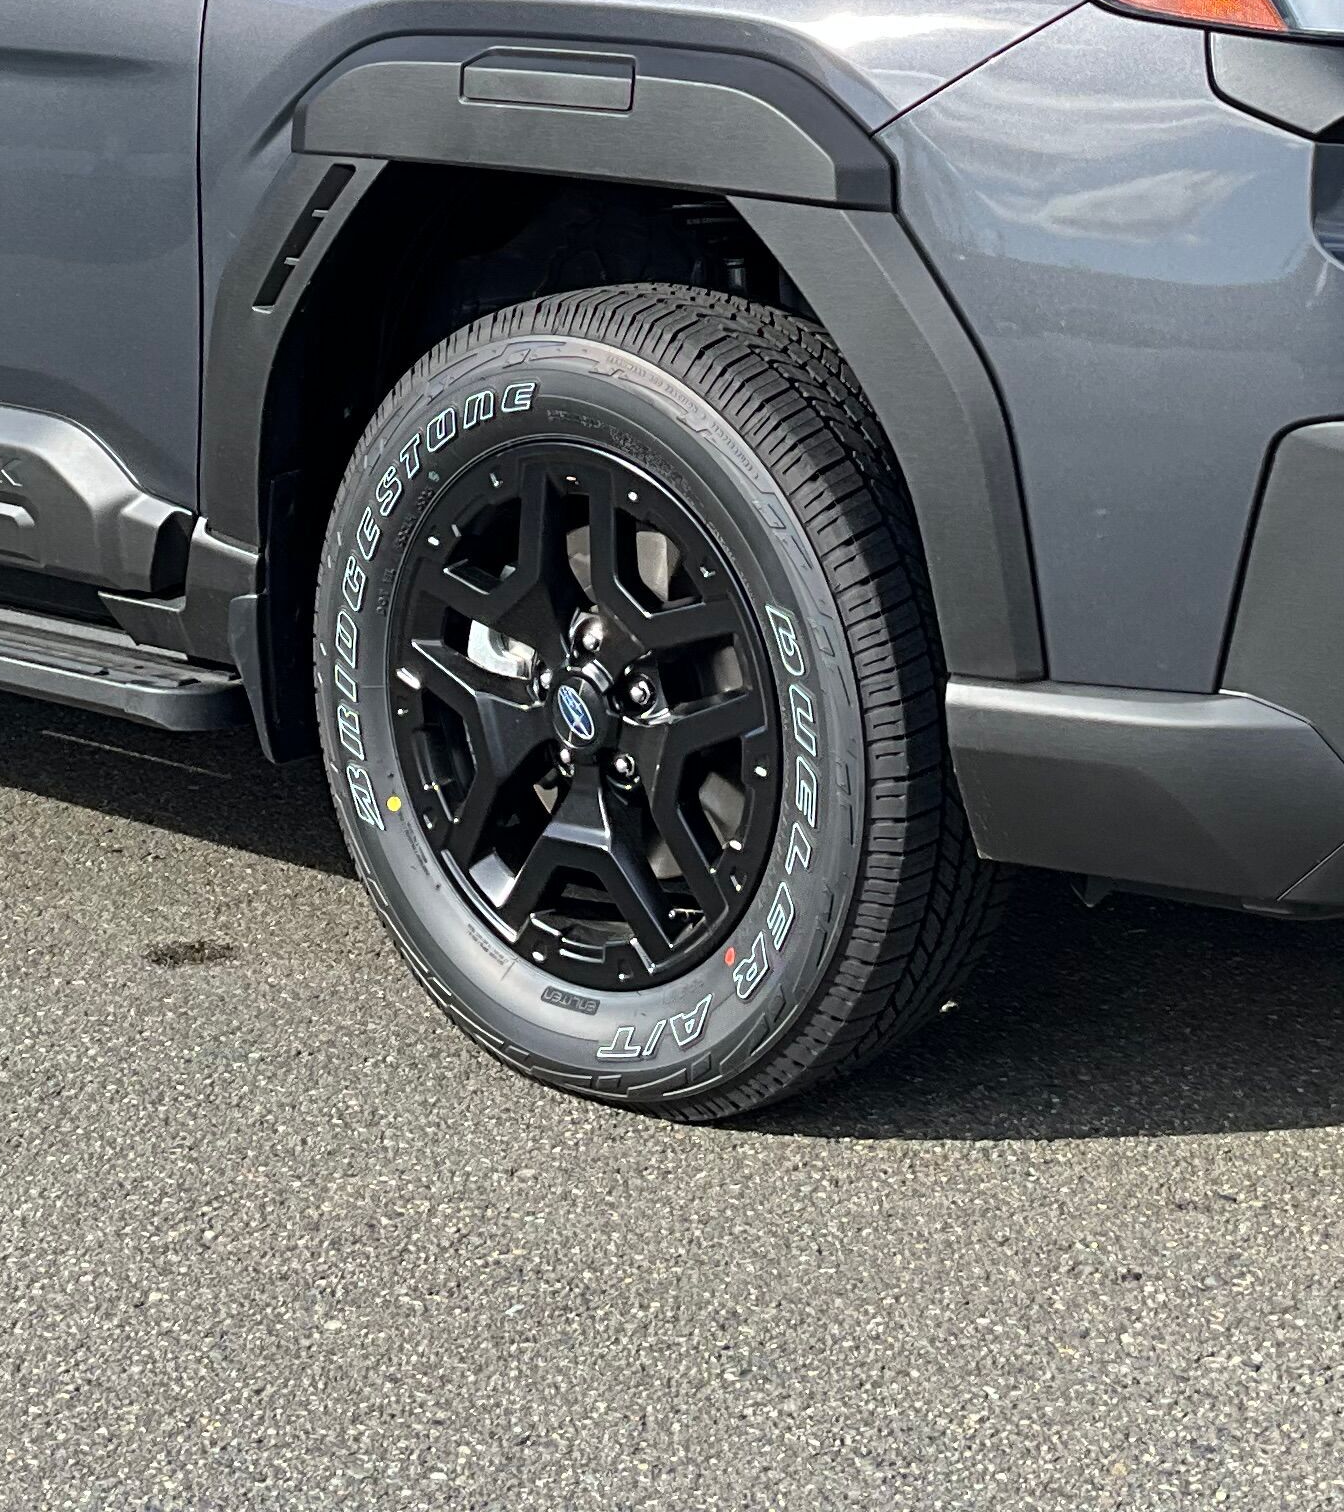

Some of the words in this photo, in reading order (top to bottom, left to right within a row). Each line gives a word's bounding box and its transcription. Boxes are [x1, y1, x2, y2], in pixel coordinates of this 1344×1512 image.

[334, 381, 536, 831] BRIDGESTONE
[732, 604, 819, 1000] DUELER
[596, 992, 713, 1058] A/T
